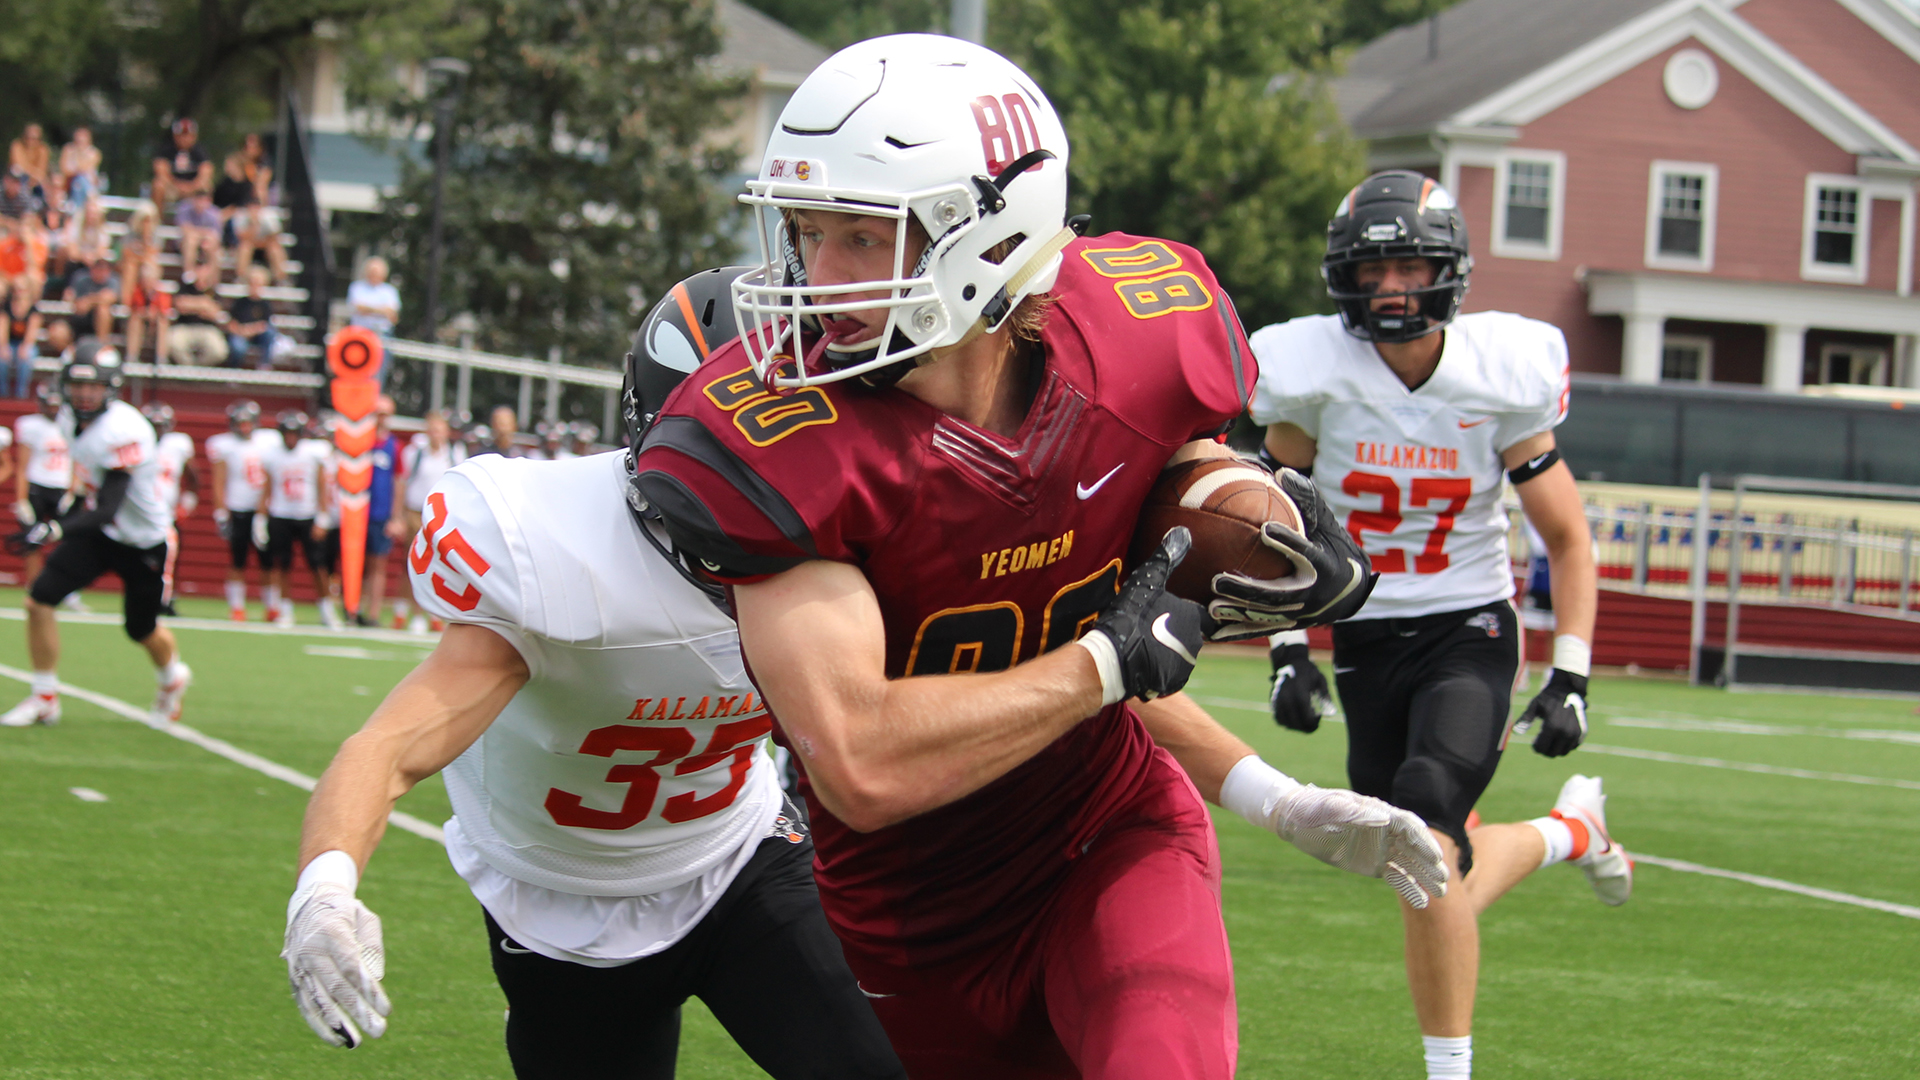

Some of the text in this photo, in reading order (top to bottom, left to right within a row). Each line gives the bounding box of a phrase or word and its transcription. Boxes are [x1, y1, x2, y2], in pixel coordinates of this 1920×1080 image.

[770, 159, 786, 177] OH
[970, 93, 1044, 177] 80
[1080, 241, 1213, 319] 80
[702, 355, 838, 447] 80
[1355, 442, 1458, 471] KALAMAZOO
[408, 492, 490, 612] 35
[980, 530, 1075, 580] YEOMEN
[1342, 470, 1472, 575] 27
[626, 692, 765, 720] KALAMA
[544, 712, 773, 831] 35
